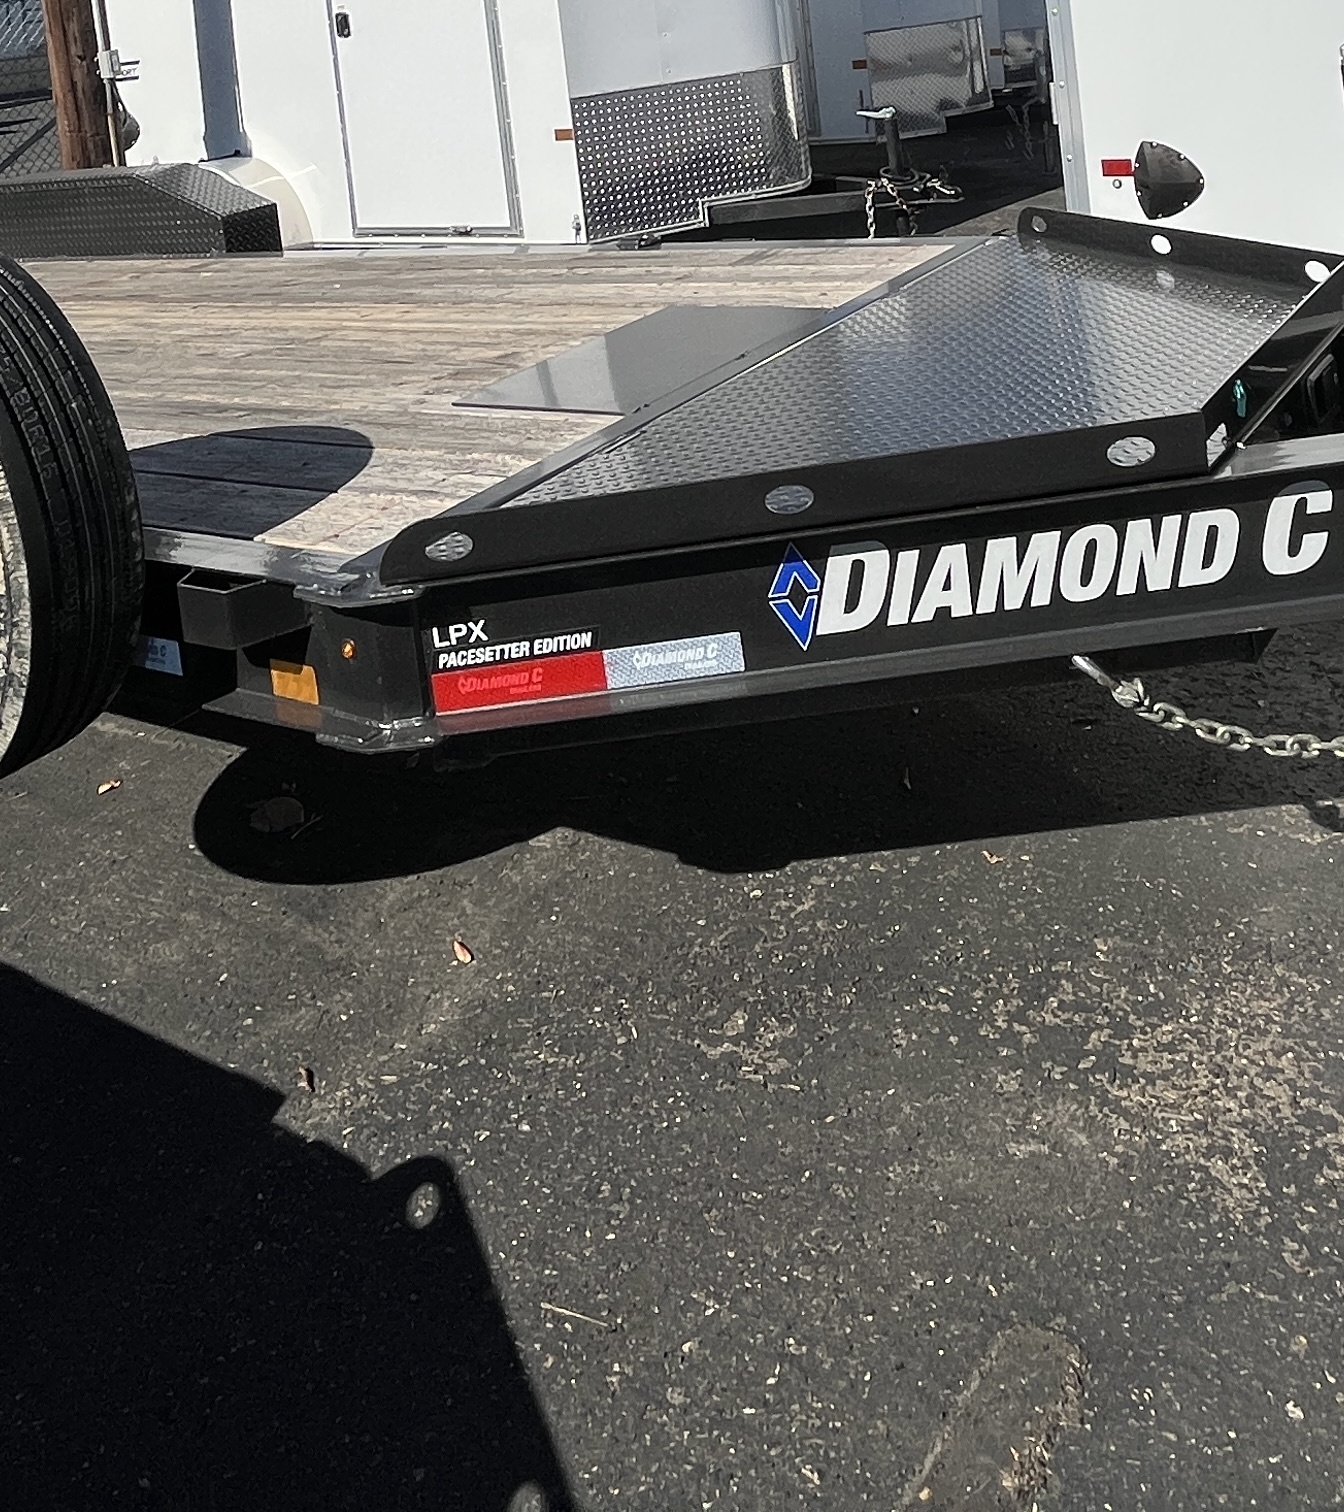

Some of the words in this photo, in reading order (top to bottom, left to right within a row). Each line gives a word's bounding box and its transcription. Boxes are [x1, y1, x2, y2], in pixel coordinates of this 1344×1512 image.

[815, 507, 1239, 636] DIAMOND
[1260, 480, 1333, 576] C
[432, 619, 488, 649] LPX
[438, 640, 530, 670] PACESETTER
[533, 631, 593, 655] EDITION
